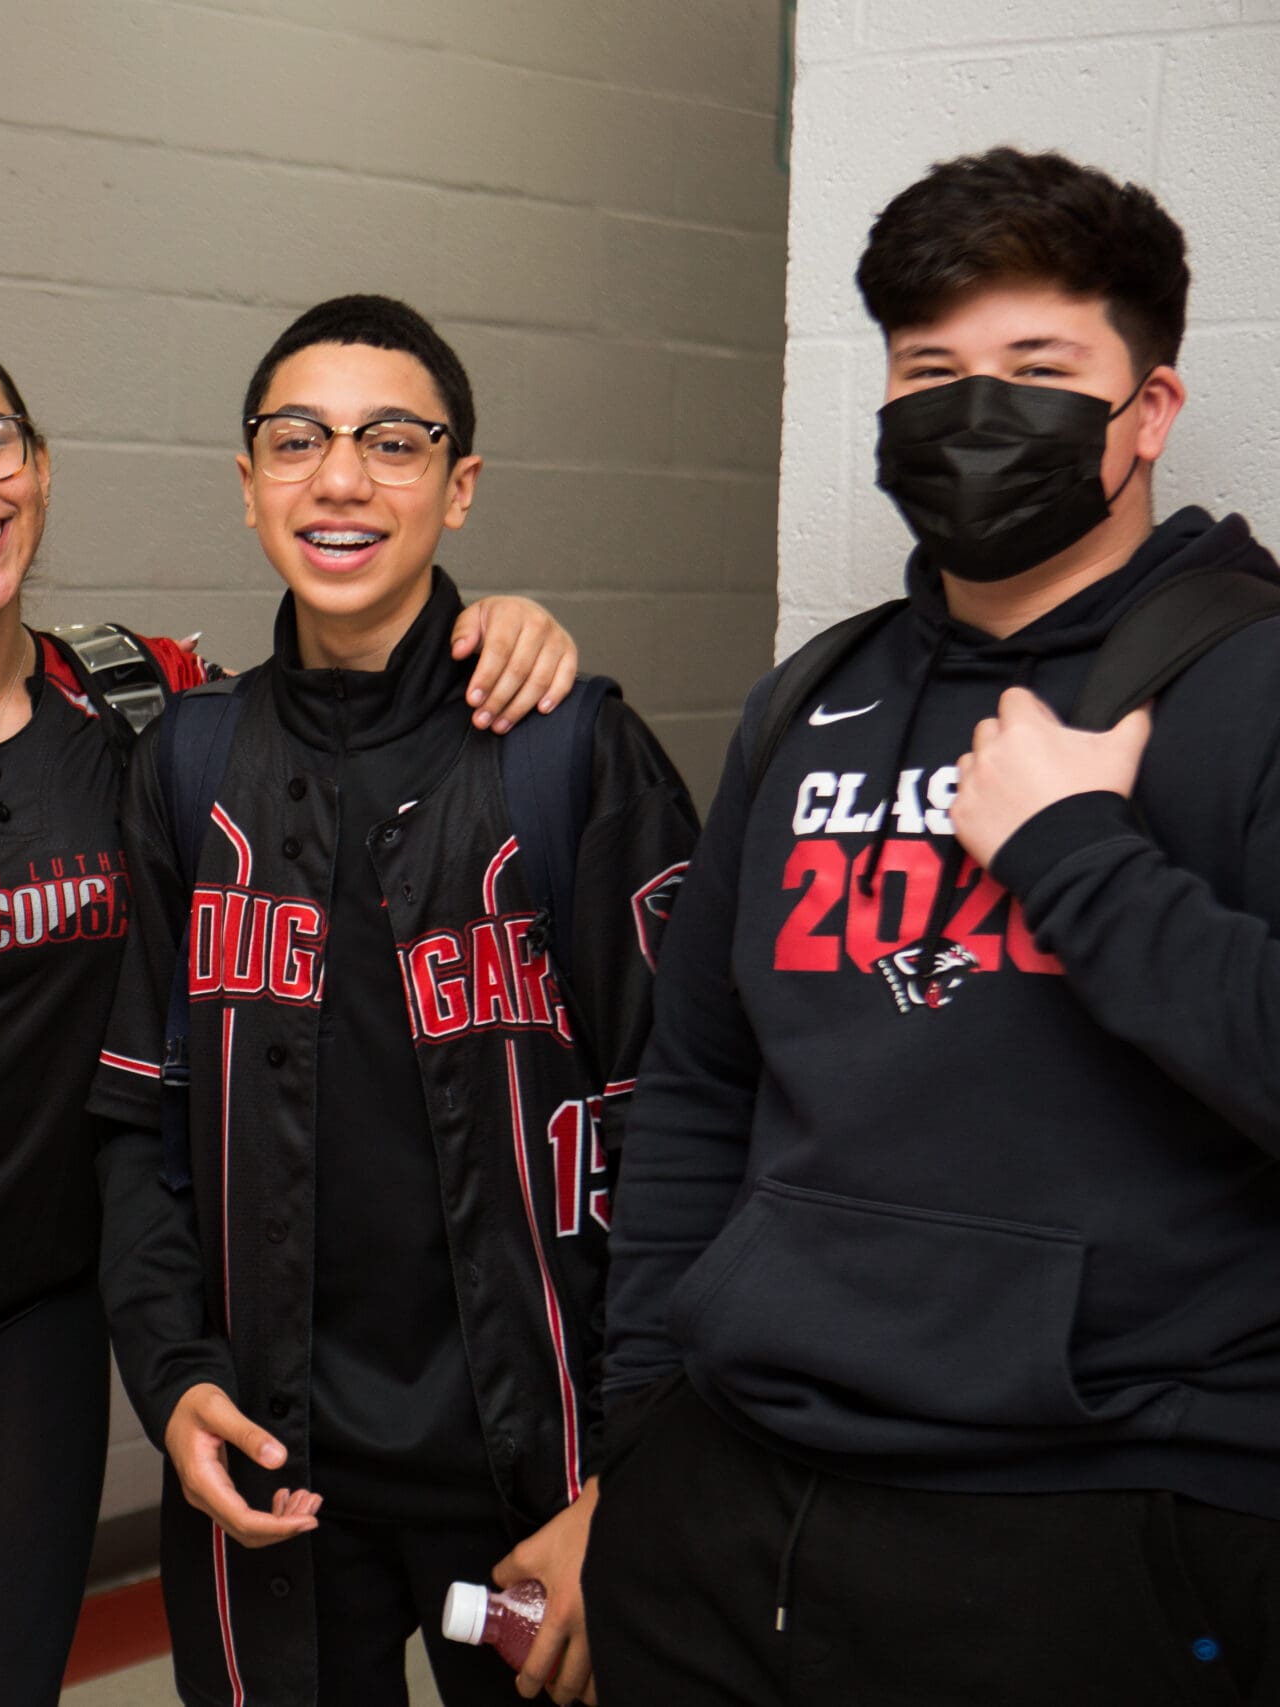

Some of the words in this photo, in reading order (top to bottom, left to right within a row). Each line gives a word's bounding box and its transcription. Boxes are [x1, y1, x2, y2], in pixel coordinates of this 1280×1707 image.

[792, 765, 960, 836] CLAS
[29, 849, 128, 882] LUTHE
[188, 883, 327, 1008] OUG
[397, 913, 574, 1048] GAR
